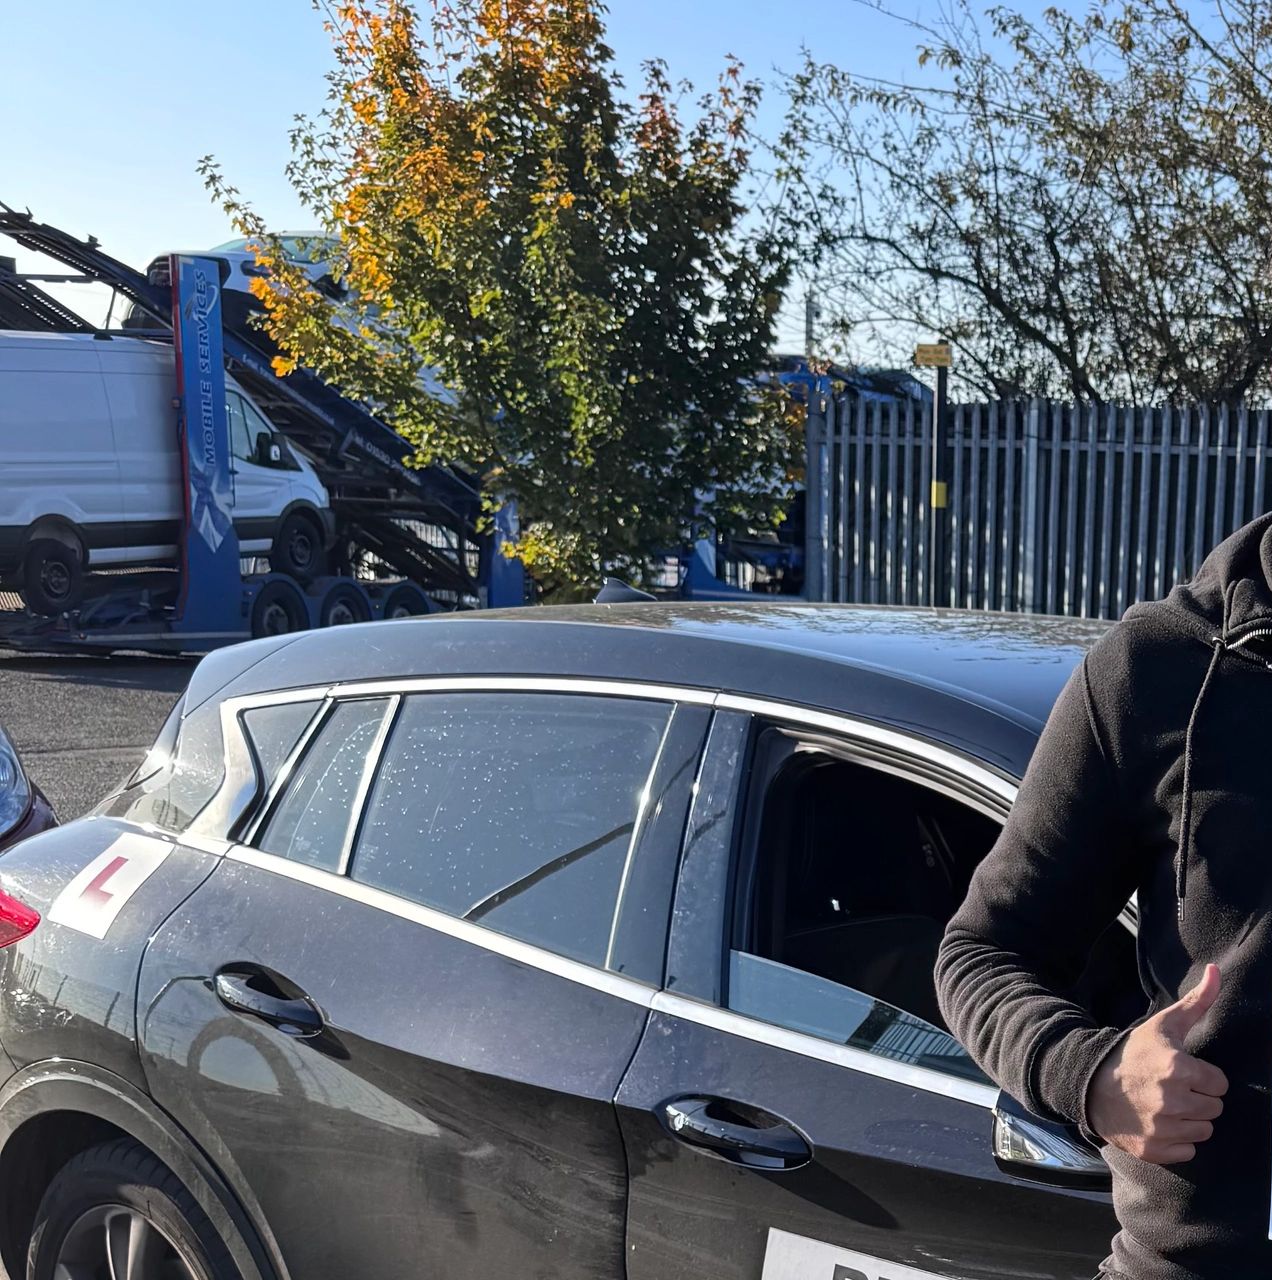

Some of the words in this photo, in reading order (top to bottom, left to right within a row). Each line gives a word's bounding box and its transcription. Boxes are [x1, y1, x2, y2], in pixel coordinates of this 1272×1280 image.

[194, 269, 213, 376] SERVICES
[200, 379, 216, 465] MOBILE
[79, 856, 129, 909] L
